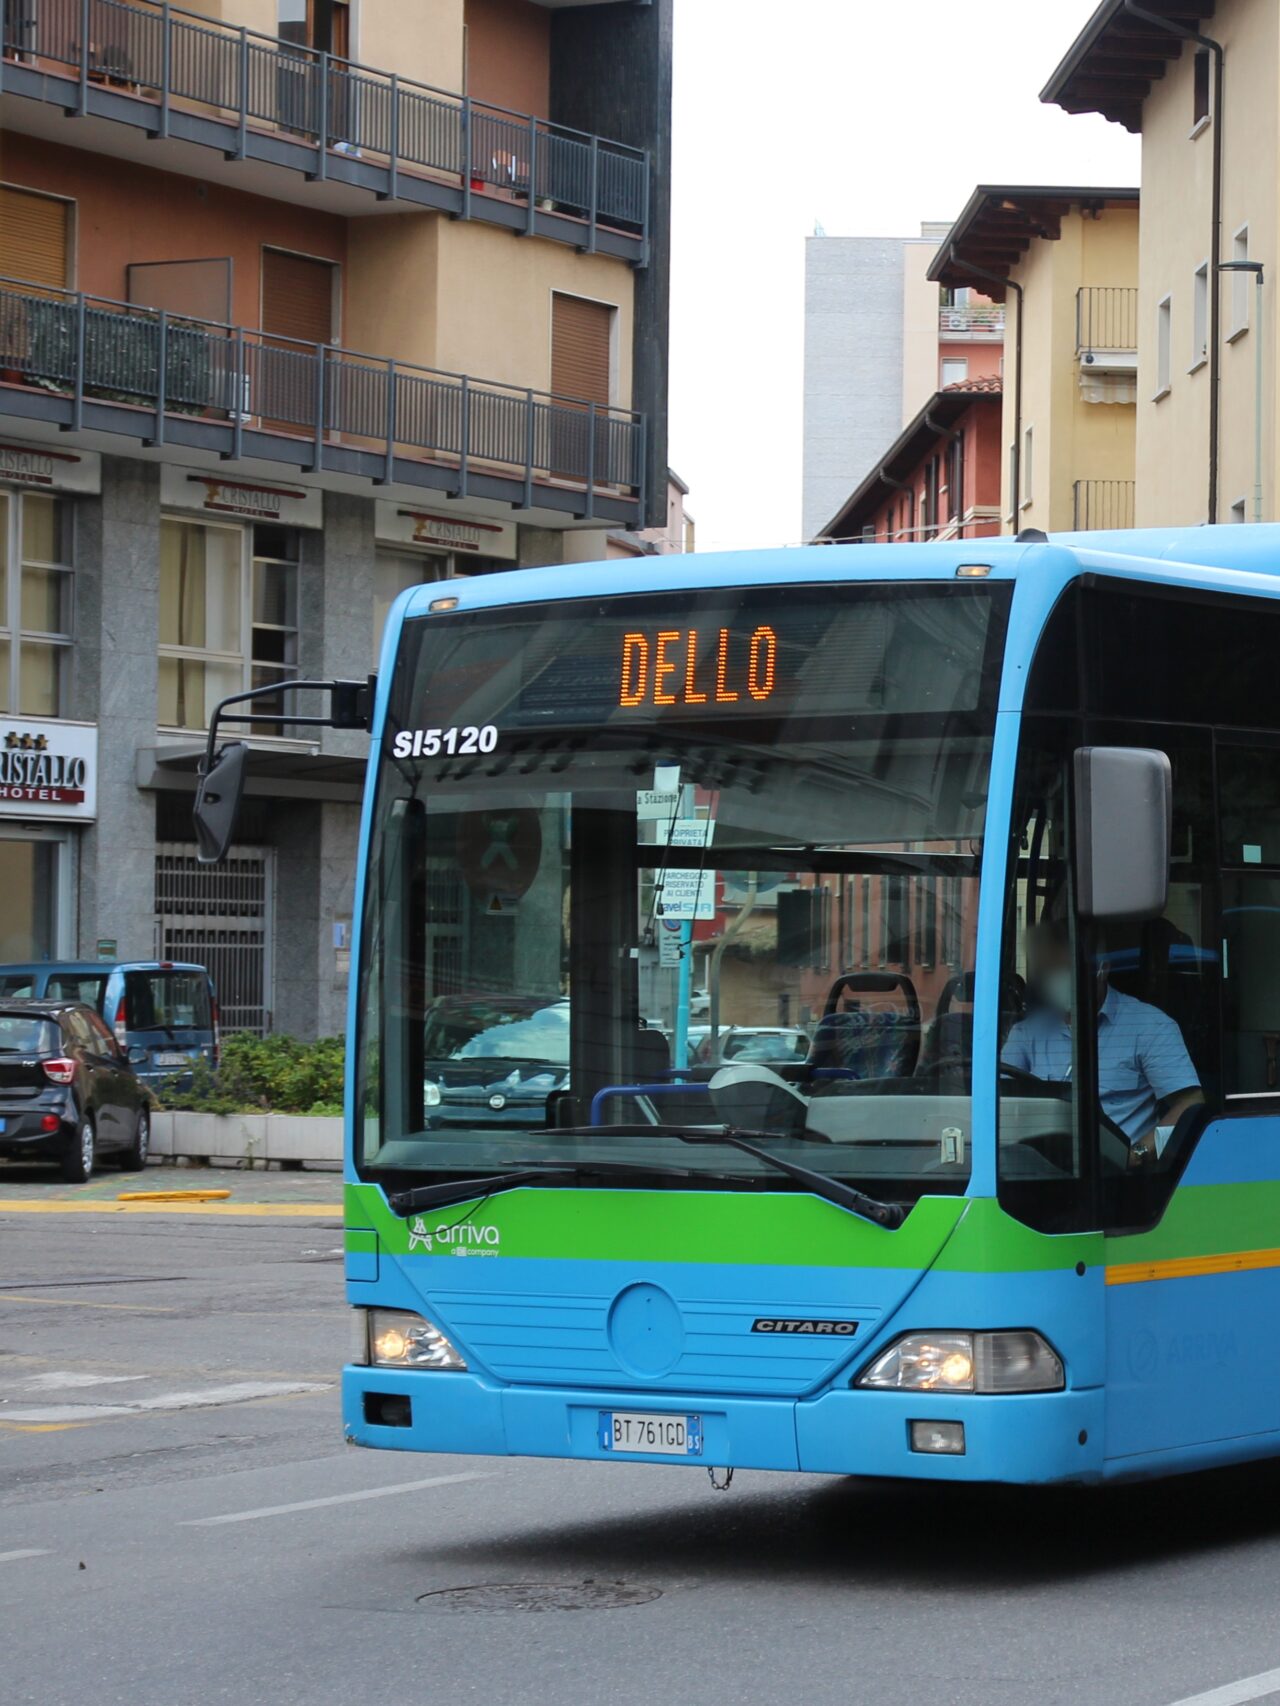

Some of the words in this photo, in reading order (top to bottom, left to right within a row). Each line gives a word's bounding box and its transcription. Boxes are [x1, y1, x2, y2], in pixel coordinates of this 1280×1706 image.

[0, 449, 53, 475] ISTALLO
[222, 487, 280, 511] CRISTALLO
[428, 519, 480, 543] CRISTALLO
[619, 625, 777, 707] DELLO
[393, 724, 499, 759] SI5120
[0, 751, 86, 788] ISTALLO
[0, 787, 61, 801] HOTEL
[664, 829, 707, 837] POPRIET
[664, 872, 708, 880] ARCHEGGO
[435, 1220, 500, 1245] arriva
[755, 1319, 855, 1335] CITARO
[613, 1418, 632, 1443] BT
[637, 1420, 686, 1447] 761GD
